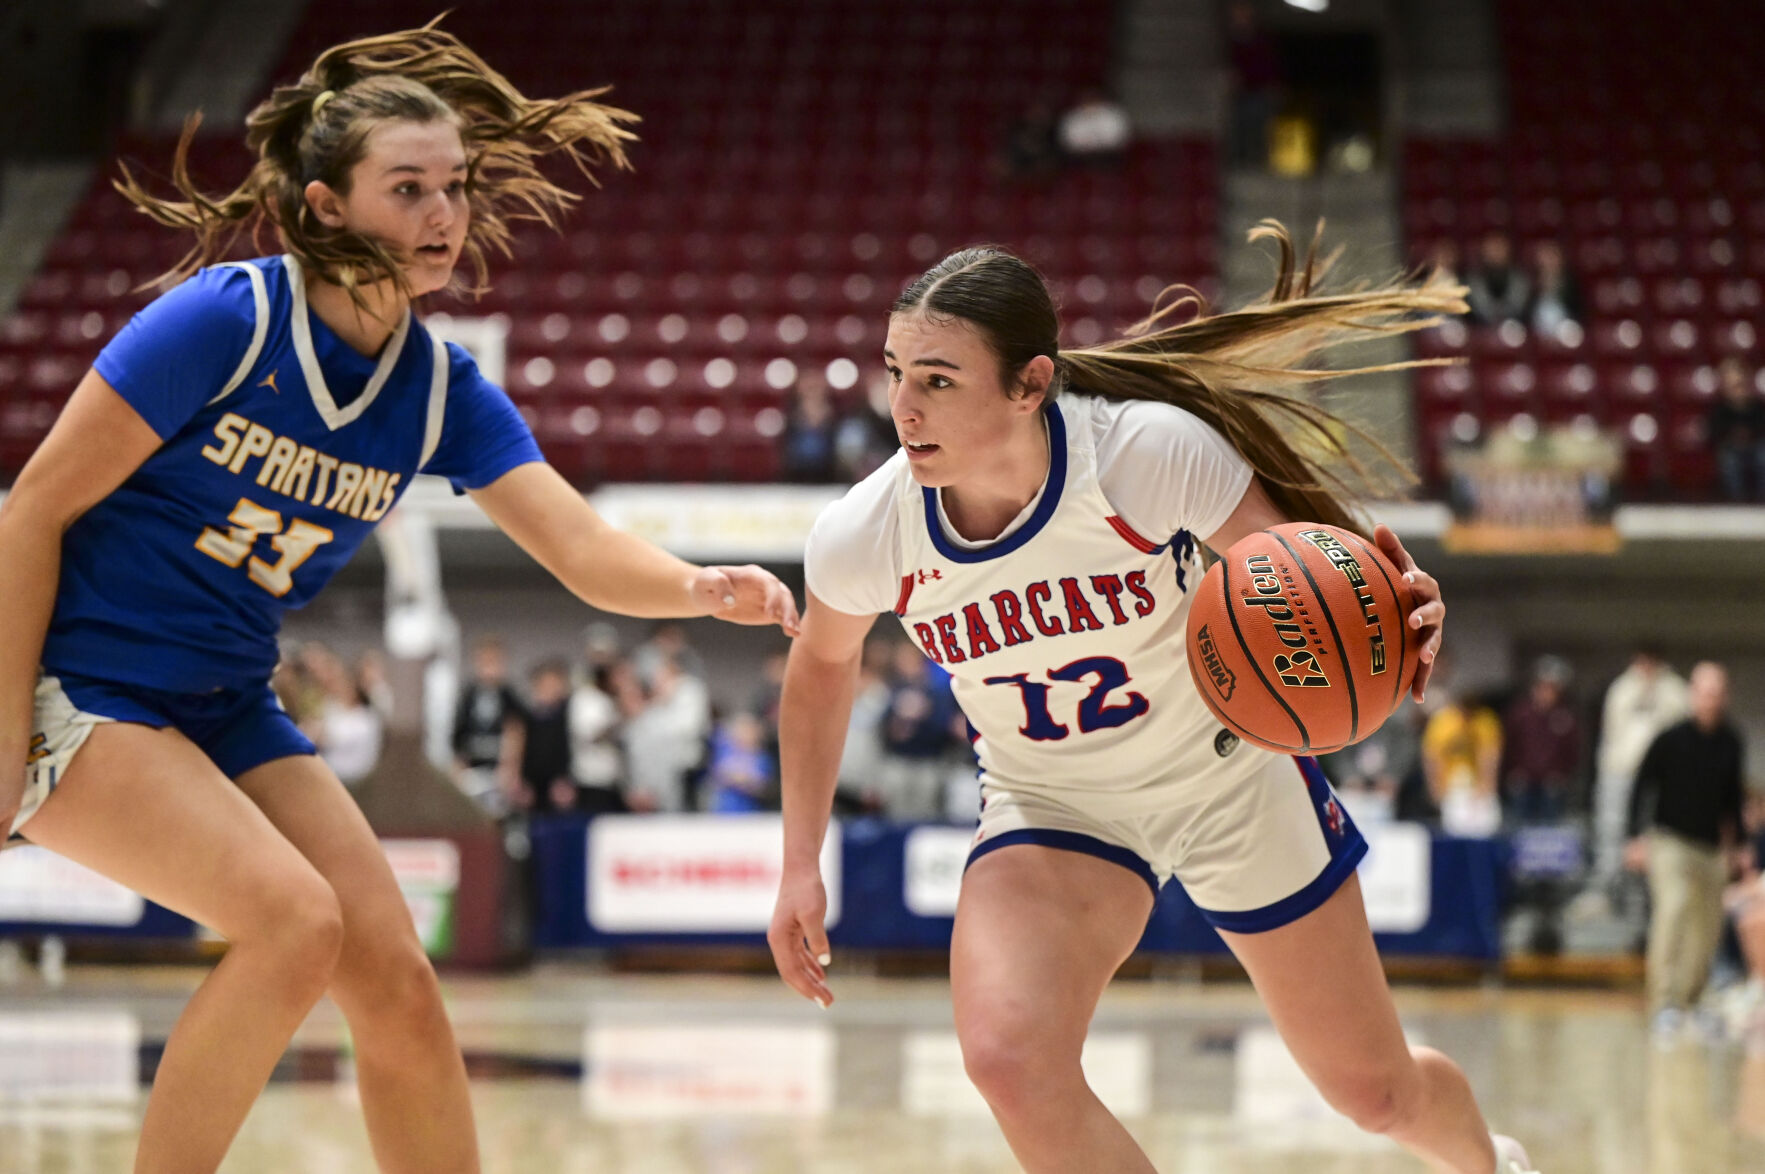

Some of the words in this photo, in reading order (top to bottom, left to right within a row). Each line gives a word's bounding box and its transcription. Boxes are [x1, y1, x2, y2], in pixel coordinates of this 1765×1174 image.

[201, 411, 401, 522] SPARTANS
[194, 497, 334, 597] 33
[913, 570, 1156, 665] BEARCATS
[1197, 624, 1230, 688] MHSA
[1243, 555, 1331, 687] Baden
[1281, 567, 1328, 655] PERFECTION
[1338, 561, 1387, 676] ELITE
[982, 655, 1150, 742] 12
